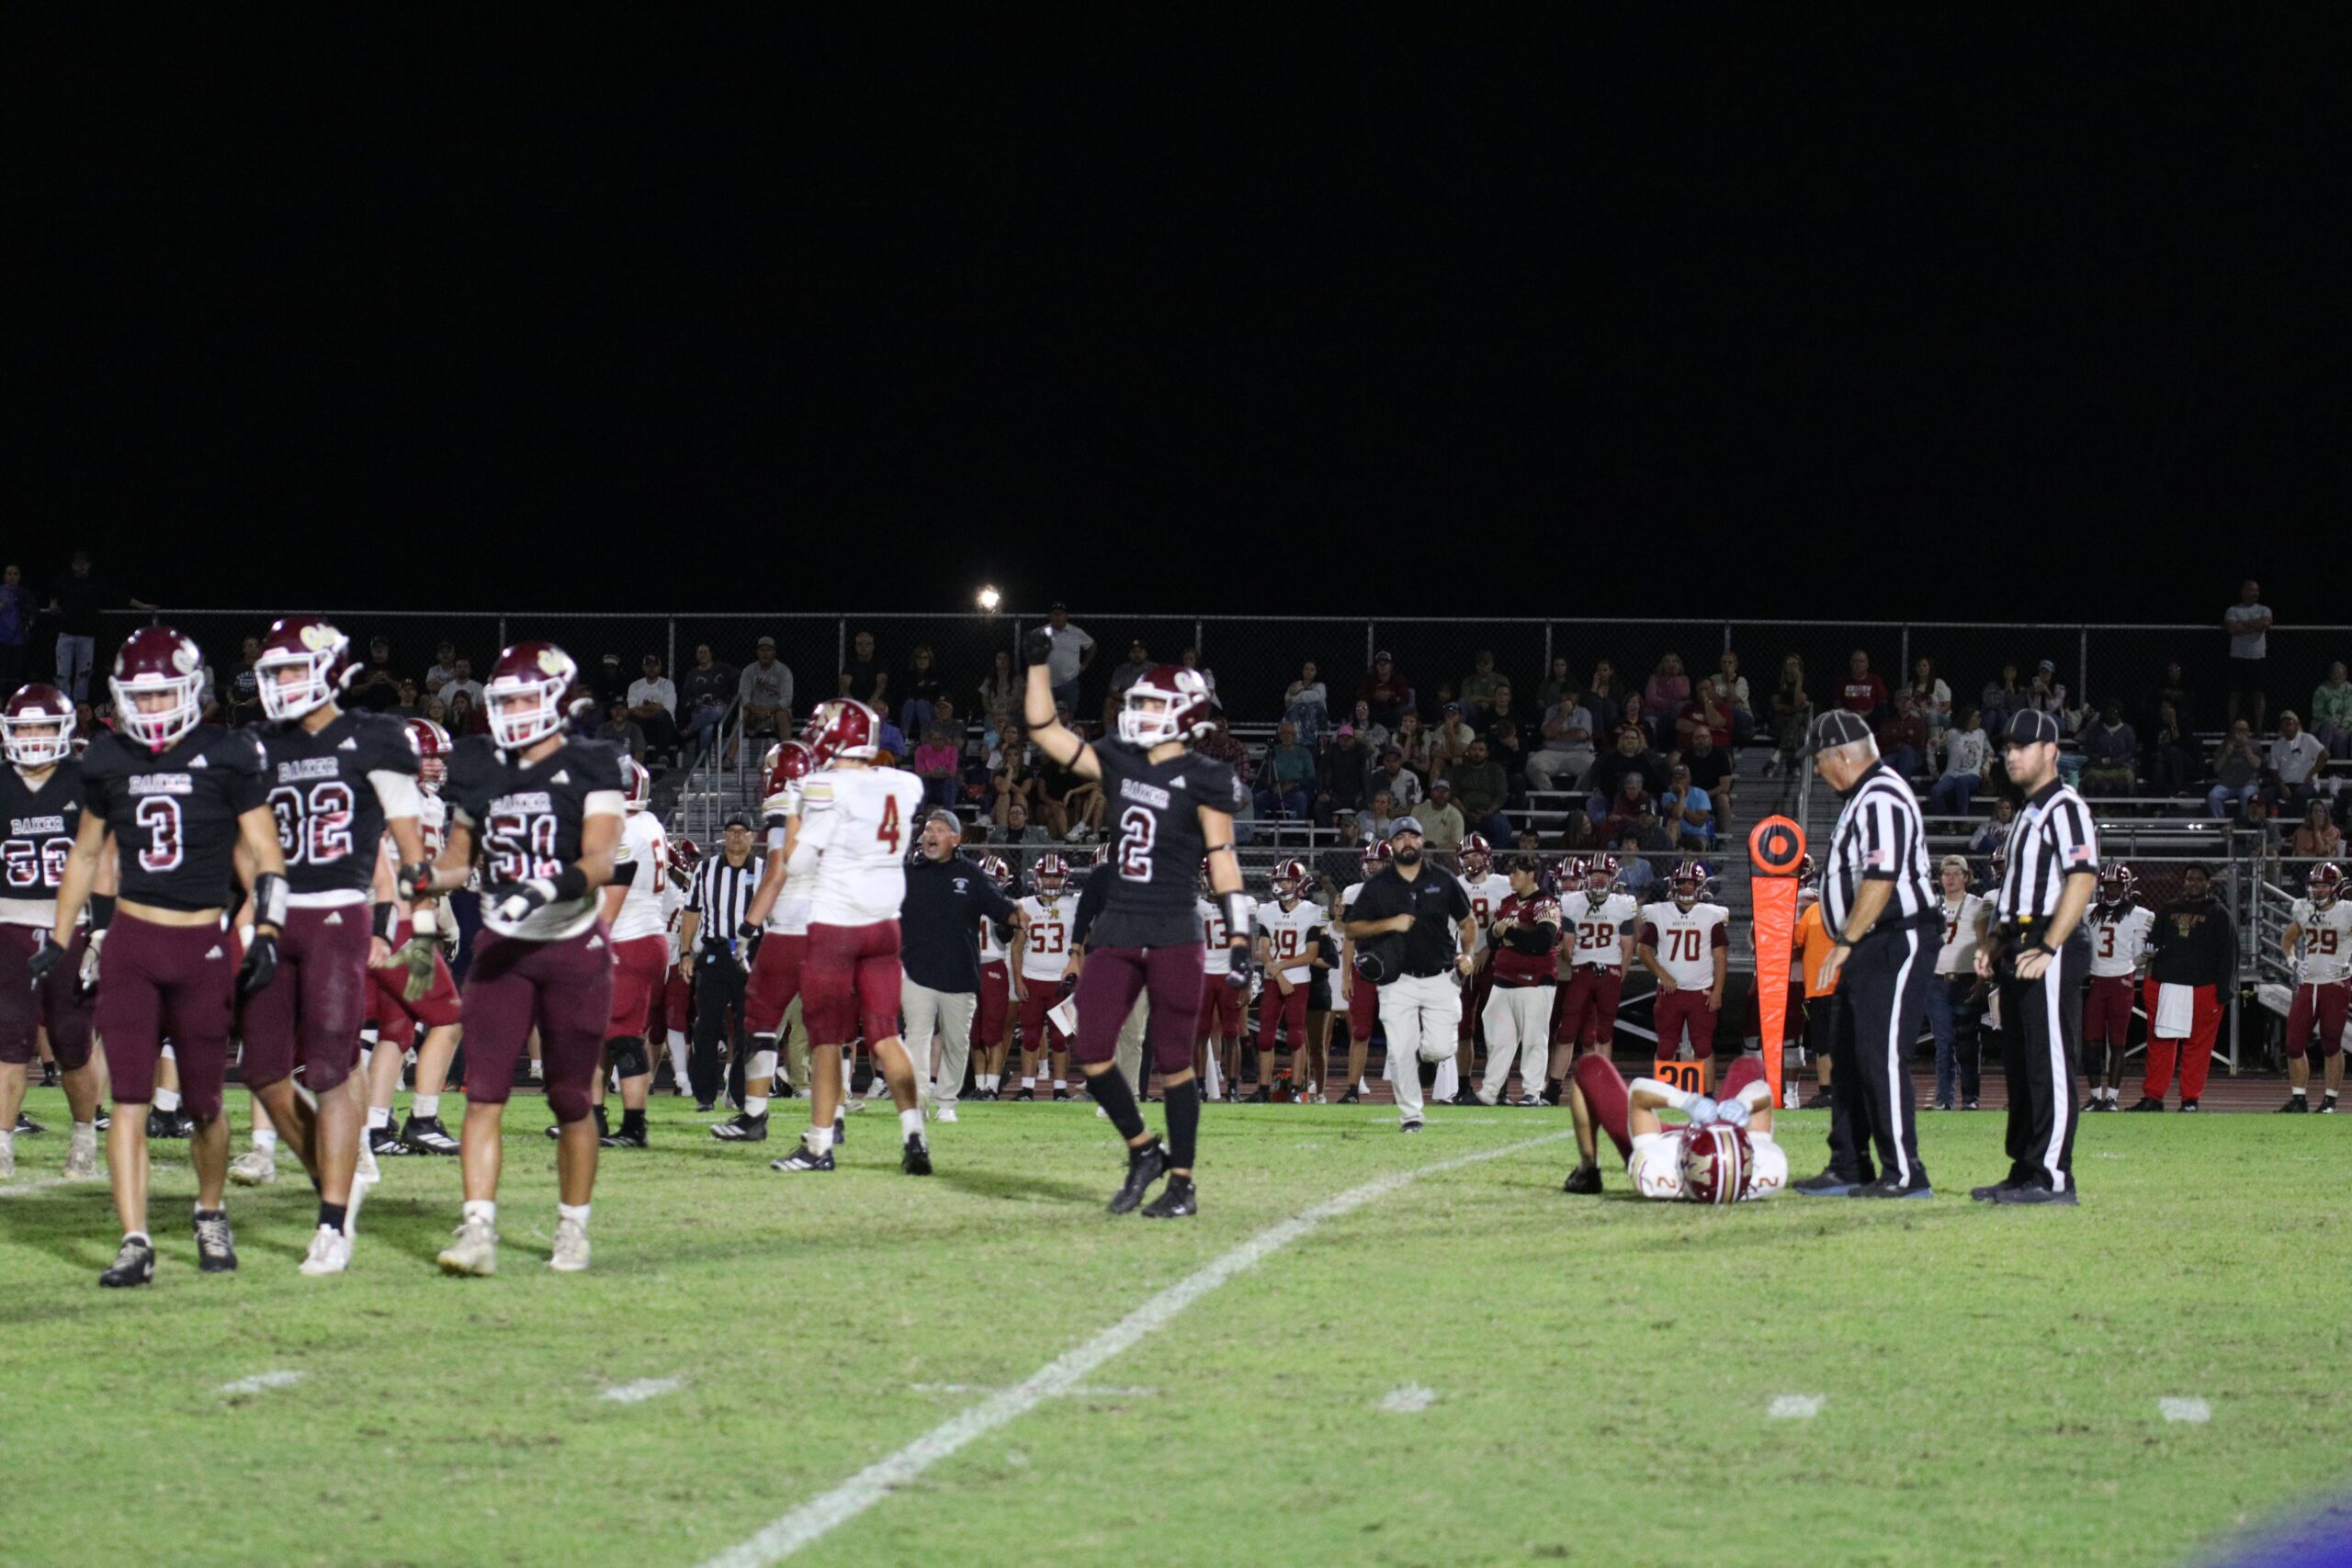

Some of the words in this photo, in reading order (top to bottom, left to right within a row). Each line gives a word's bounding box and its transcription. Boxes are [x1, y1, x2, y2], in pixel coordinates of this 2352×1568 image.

[128, 773, 193, 795] BAKER
[277, 757, 339, 782] BAKER
[488, 791, 552, 817] BAKER
[1120, 777, 1170, 810] BAKER
[10, 815, 65, 836] BAKER
[135, 795, 183, 872] 3
[266, 781, 355, 866] 32
[876, 794, 900, 855] 4
[481, 813, 563, 884] 51
[1118, 806, 1157, 883] 2
[1030, 922, 1065, 953] 53
[1204, 919, 1230, 950] 13
[1273, 929, 1298, 960] 19
[1578, 922, 1614, 950] 28
[1666, 929, 1702, 962] 70
[2098, 926, 2115, 958] 3
[2305, 928, 2338, 955] 29
